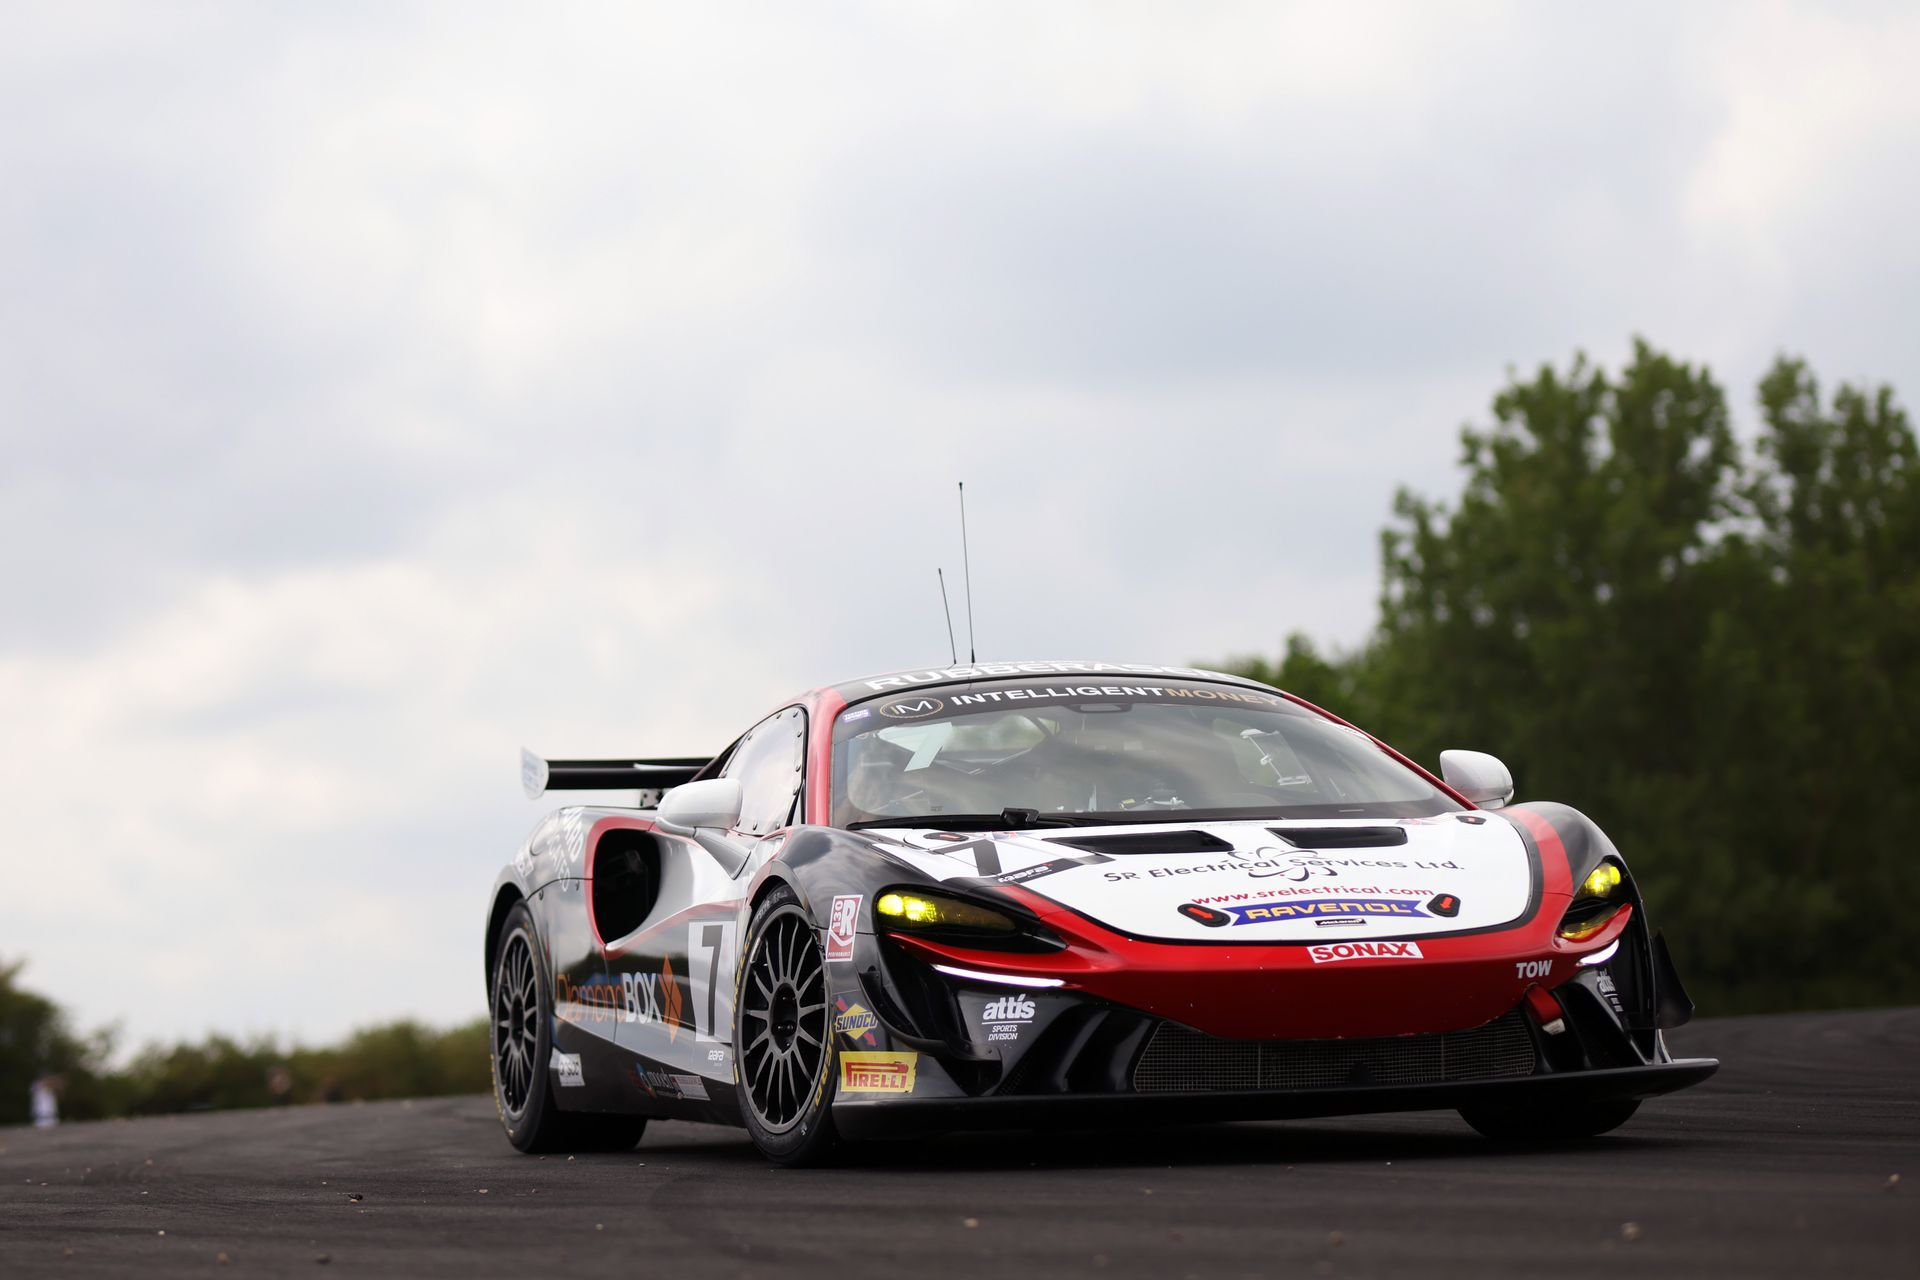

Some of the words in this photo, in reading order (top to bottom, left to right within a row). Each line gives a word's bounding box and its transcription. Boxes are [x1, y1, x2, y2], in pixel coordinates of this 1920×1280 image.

[950, 686, 1280, 707] INTELLIGENTMONEY
[1103, 872, 1141, 882] SR
[1147, 859, 1281, 878] Electrical
[1288, 858, 1408, 869] Services
[1414, 860, 1466, 870] Ltd.
[1191, 885, 1436, 905] www.srelectrical.com
[1245, 902, 1413, 920] RAVENOL
[1312, 943, 1414, 961] SONAX
[1516, 960, 1552, 979] TOW
[702, 924, 723, 1037] 7
[988, 1033, 1019, 1041] DIVISION
[992, 1025, 1018, 1033] SPORTS
[845, 1062, 909, 1094] PIRELLI
